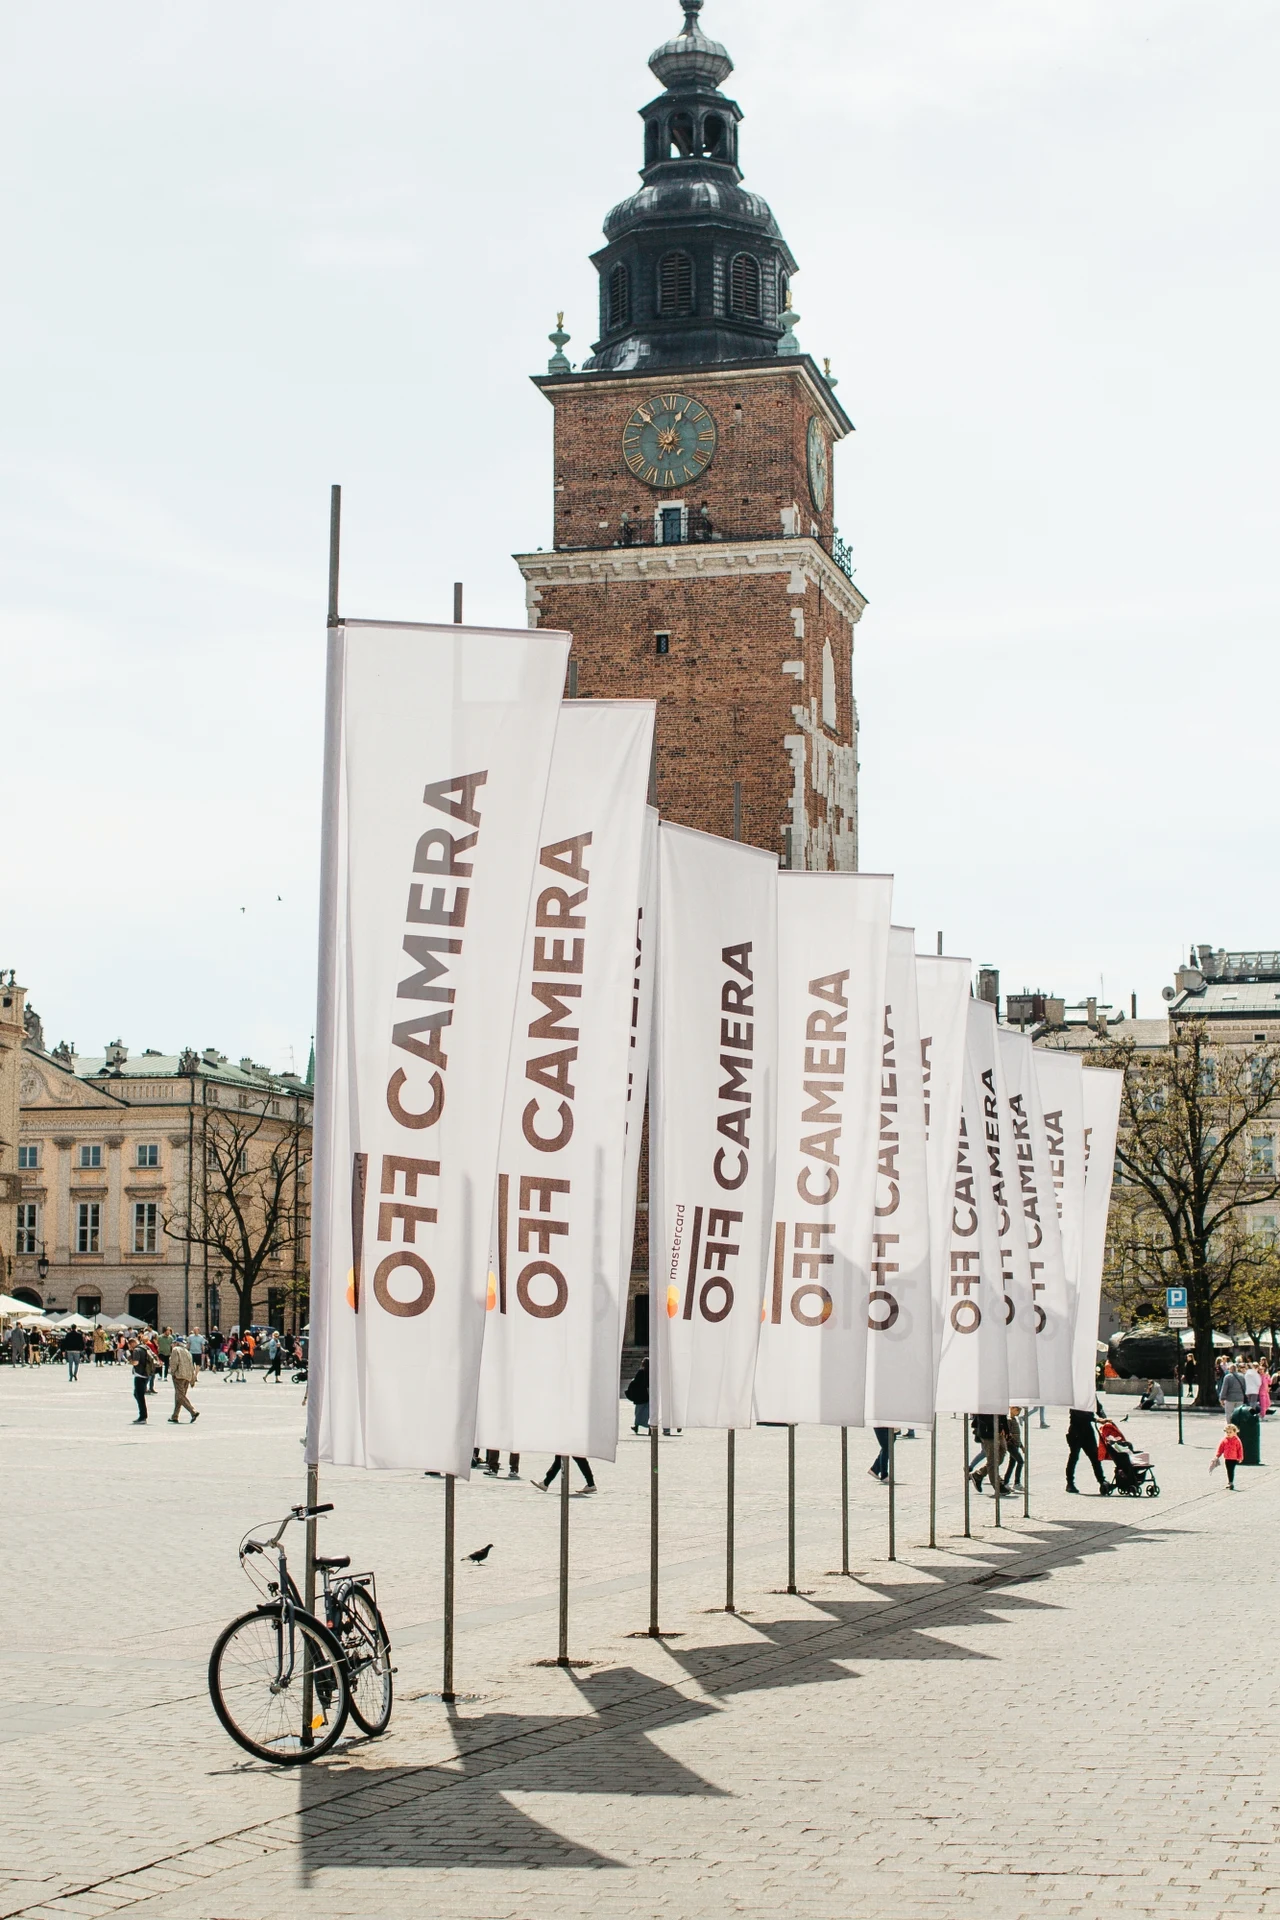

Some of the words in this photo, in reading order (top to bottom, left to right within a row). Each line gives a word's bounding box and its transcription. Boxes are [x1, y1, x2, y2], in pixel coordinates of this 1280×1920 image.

[387, 769, 489, 1130] CAMERA
[522, 831, 593, 1153] CAMERA
[714, 941, 754, 1191] CAMERA
[797, 969, 850, 1206] CAMERA
[373, 1154, 441, 1318] OFF
[517, 1175, 571, 1319] OFF
[669, 1204, 685, 1280] mastercard
[699, 1207, 744, 1324] OFF
[790, 1222, 836, 1327] OFF
[951, 1251, 982, 1334] OFF
[1171, 1290, 1183, 1306] P
